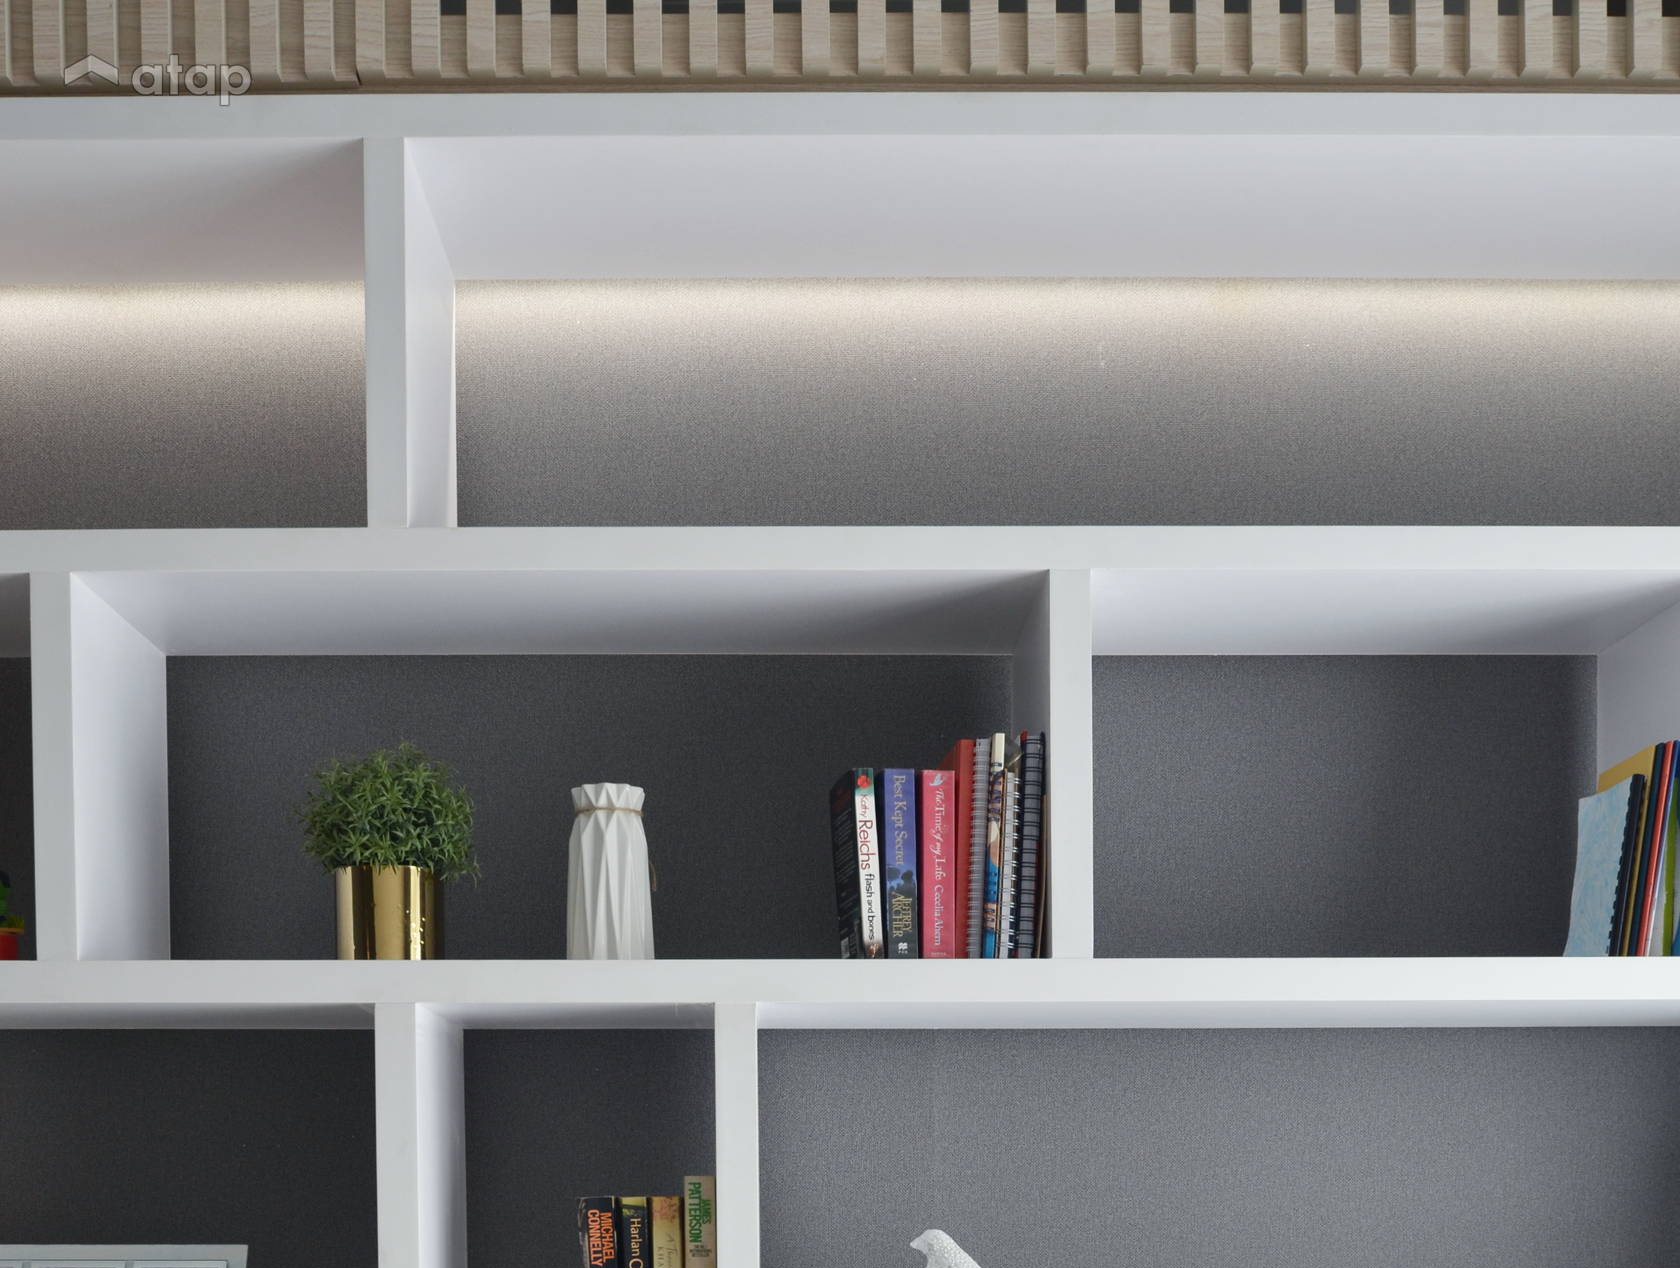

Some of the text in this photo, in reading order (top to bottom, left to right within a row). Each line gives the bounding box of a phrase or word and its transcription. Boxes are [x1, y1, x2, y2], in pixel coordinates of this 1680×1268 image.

[858, 793, 876, 870] Kathy Reichs
[892, 775, 908, 865] Best Kept Secret
[935, 804, 945, 831] Time
[865, 873, 876, 940] flash and bones
[891, 891, 905, 937] ARCHER
[587, 1208, 603, 1267] CONNELLY
[600, 1211, 616, 1261] MICHAEL
[630, 1217, 641, 1257] Harlan
[688, 1182, 702, 1243] PATTERSON
